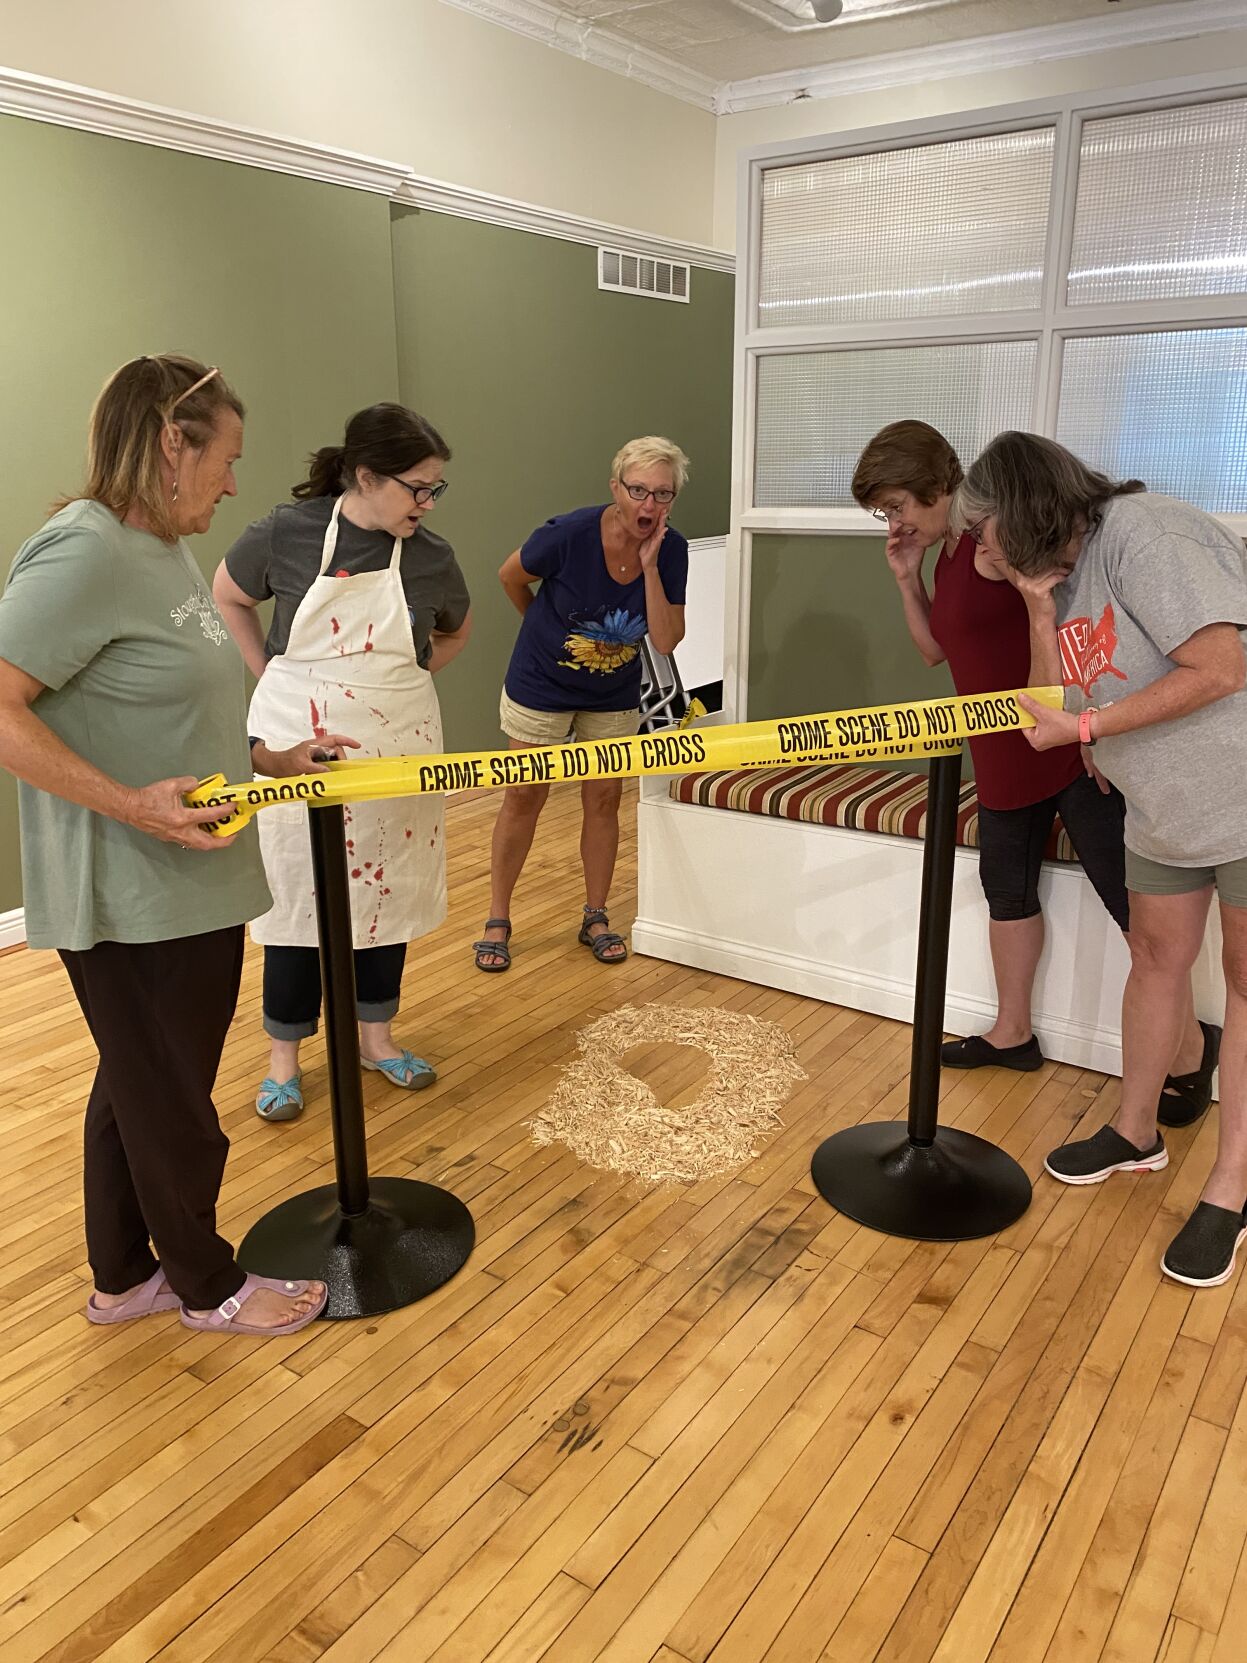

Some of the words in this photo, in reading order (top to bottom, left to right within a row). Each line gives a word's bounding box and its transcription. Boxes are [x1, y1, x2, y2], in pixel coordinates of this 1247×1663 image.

[778, 720, 833, 753] CRIME
[836, 713, 892, 746] SCENE
[894, 709, 921, 739] DO
[923, 705, 957, 736] NOT
[963, 697, 1020, 730] CROSS
[420, 760, 484, 791] CRIME
[490, 752, 556, 785] SCENE
[561, 748, 588, 777] DO
[595, 742, 632, 773] NOT
[641, 734, 705, 768] CROSS
